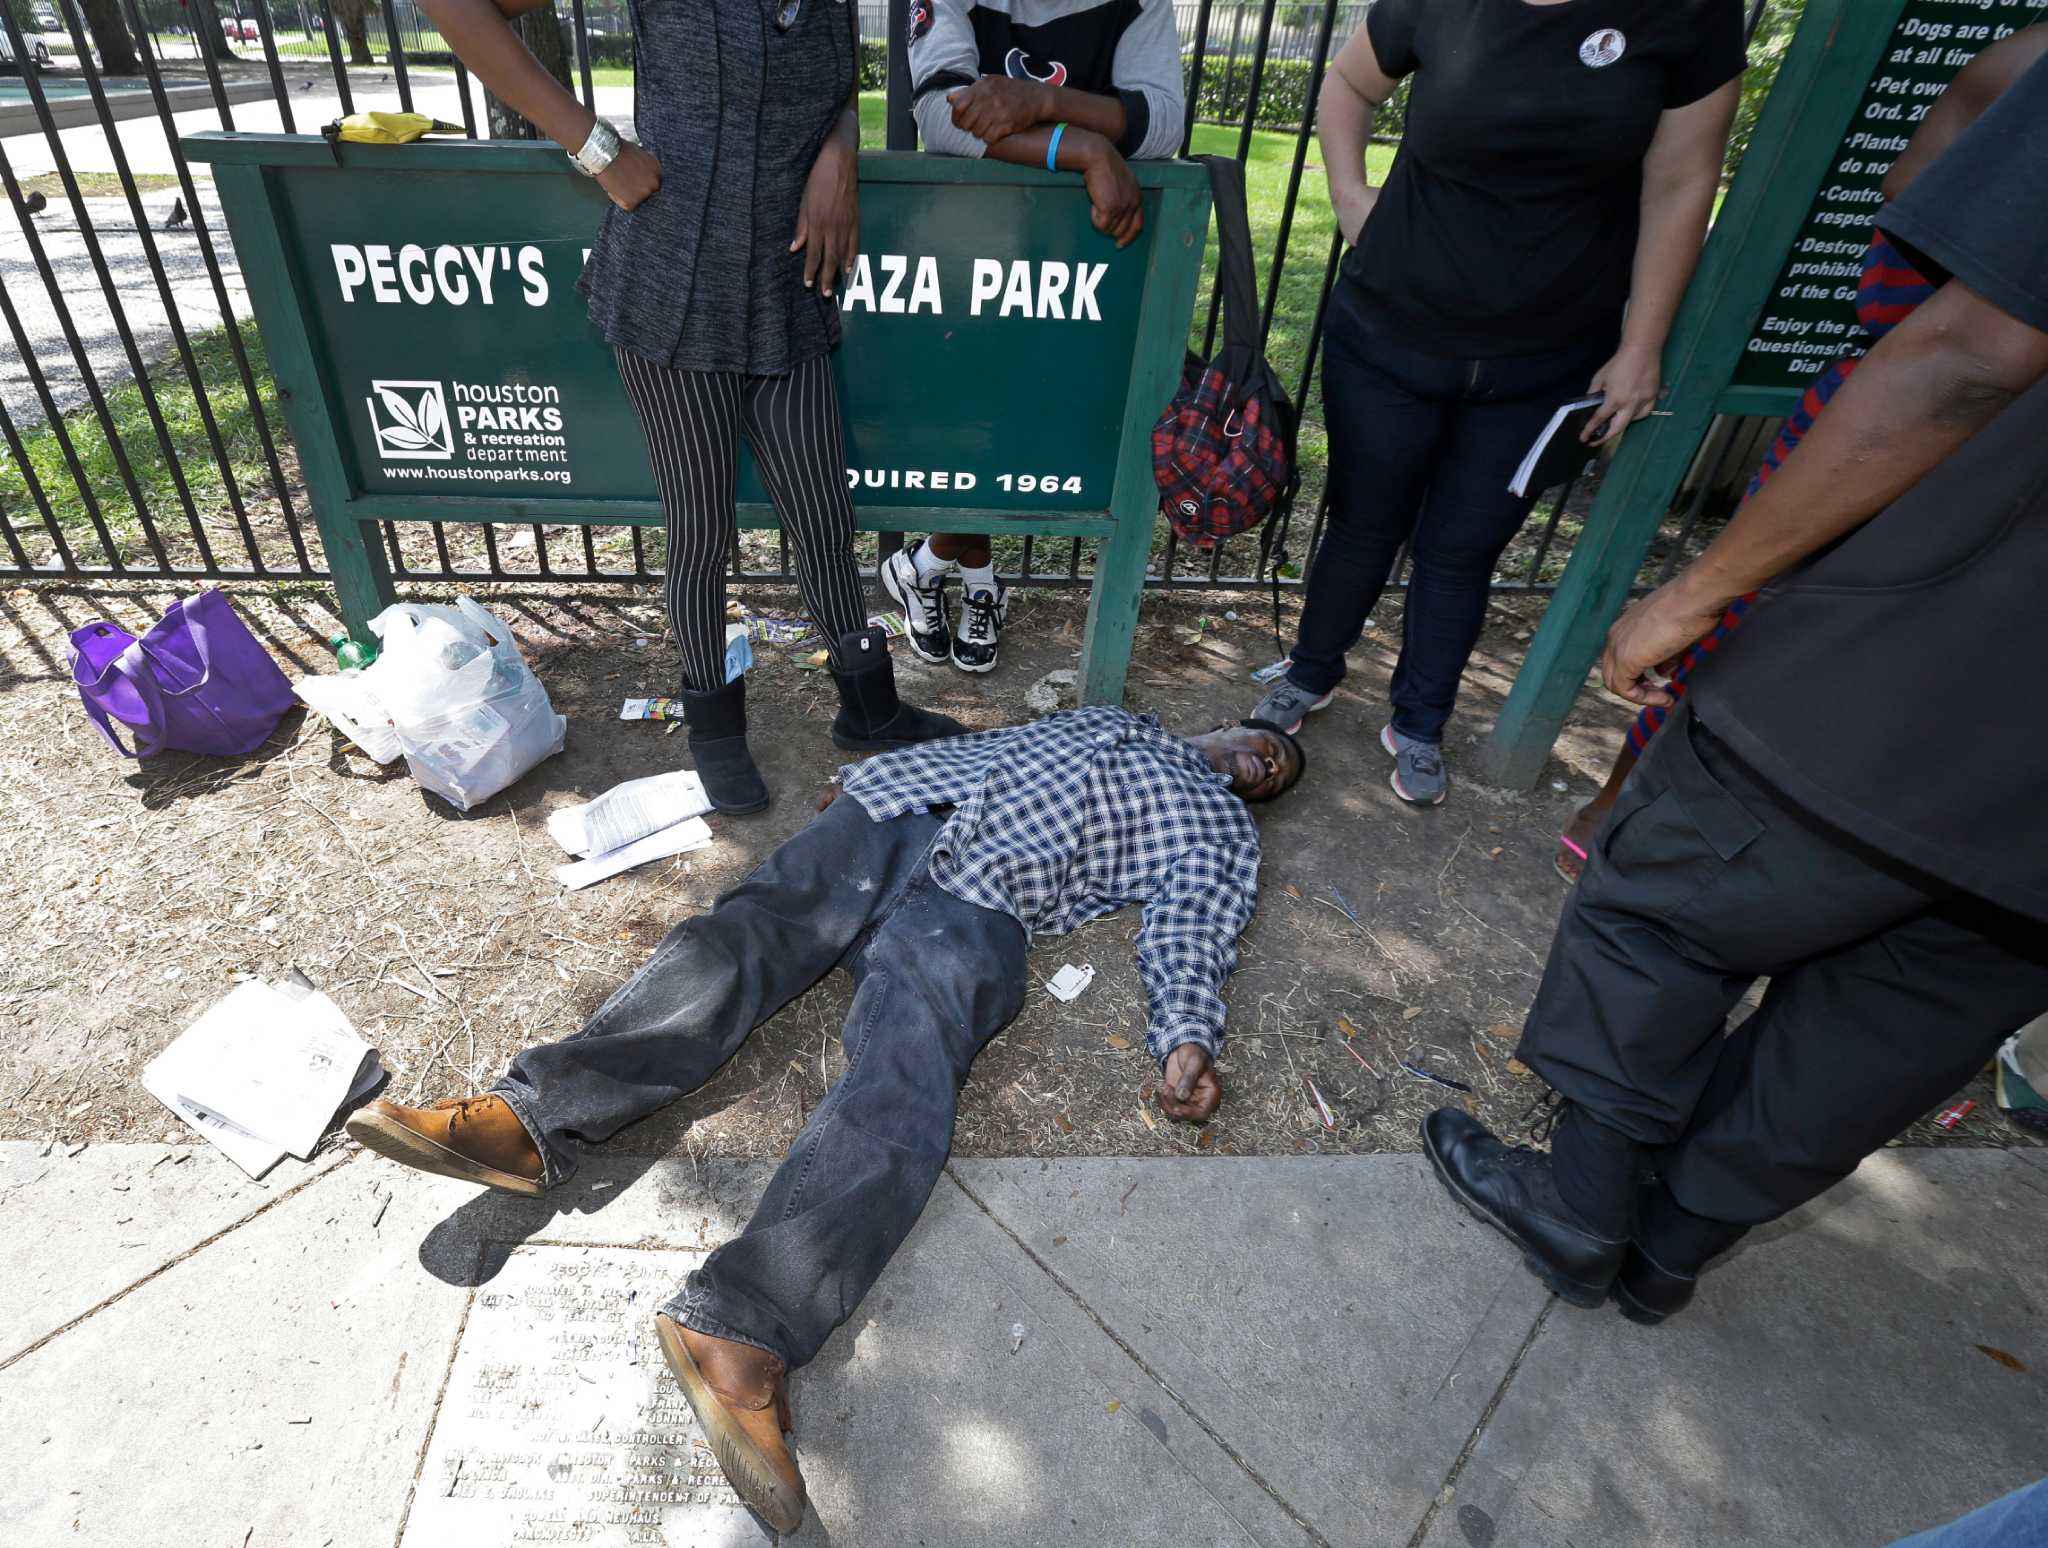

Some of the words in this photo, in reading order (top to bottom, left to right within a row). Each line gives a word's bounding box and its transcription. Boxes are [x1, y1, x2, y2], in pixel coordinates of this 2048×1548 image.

[1956, 25, 1989, 40] are
[1889, 46, 1913, 63] at
[1914, 47, 1943, 65] all
[1864, 102, 1902, 120] Ord.
[1838, 157, 1863, 174] do
[1864, 161, 1895, 175] no
[331, 244, 548, 306] PEGGY'S
[971, 259, 1108, 320] PARK
[1779, 284, 1801, 298] of
[1801, 285, 1830, 299] the
[1762, 316, 1813, 335] Enjoy
[1815, 320, 1845, 334] the
[1787, 359, 1825, 374] Dial
[453, 381, 559, 403] houston
[457, 407, 563, 431] PARKS
[464, 433, 476, 444] &
[482, 434, 565, 446] recreation
[467, 447, 567, 462] department
[384, 466, 571, 484] www.houstonparks.org
[996, 474, 1081, 493] 1964
